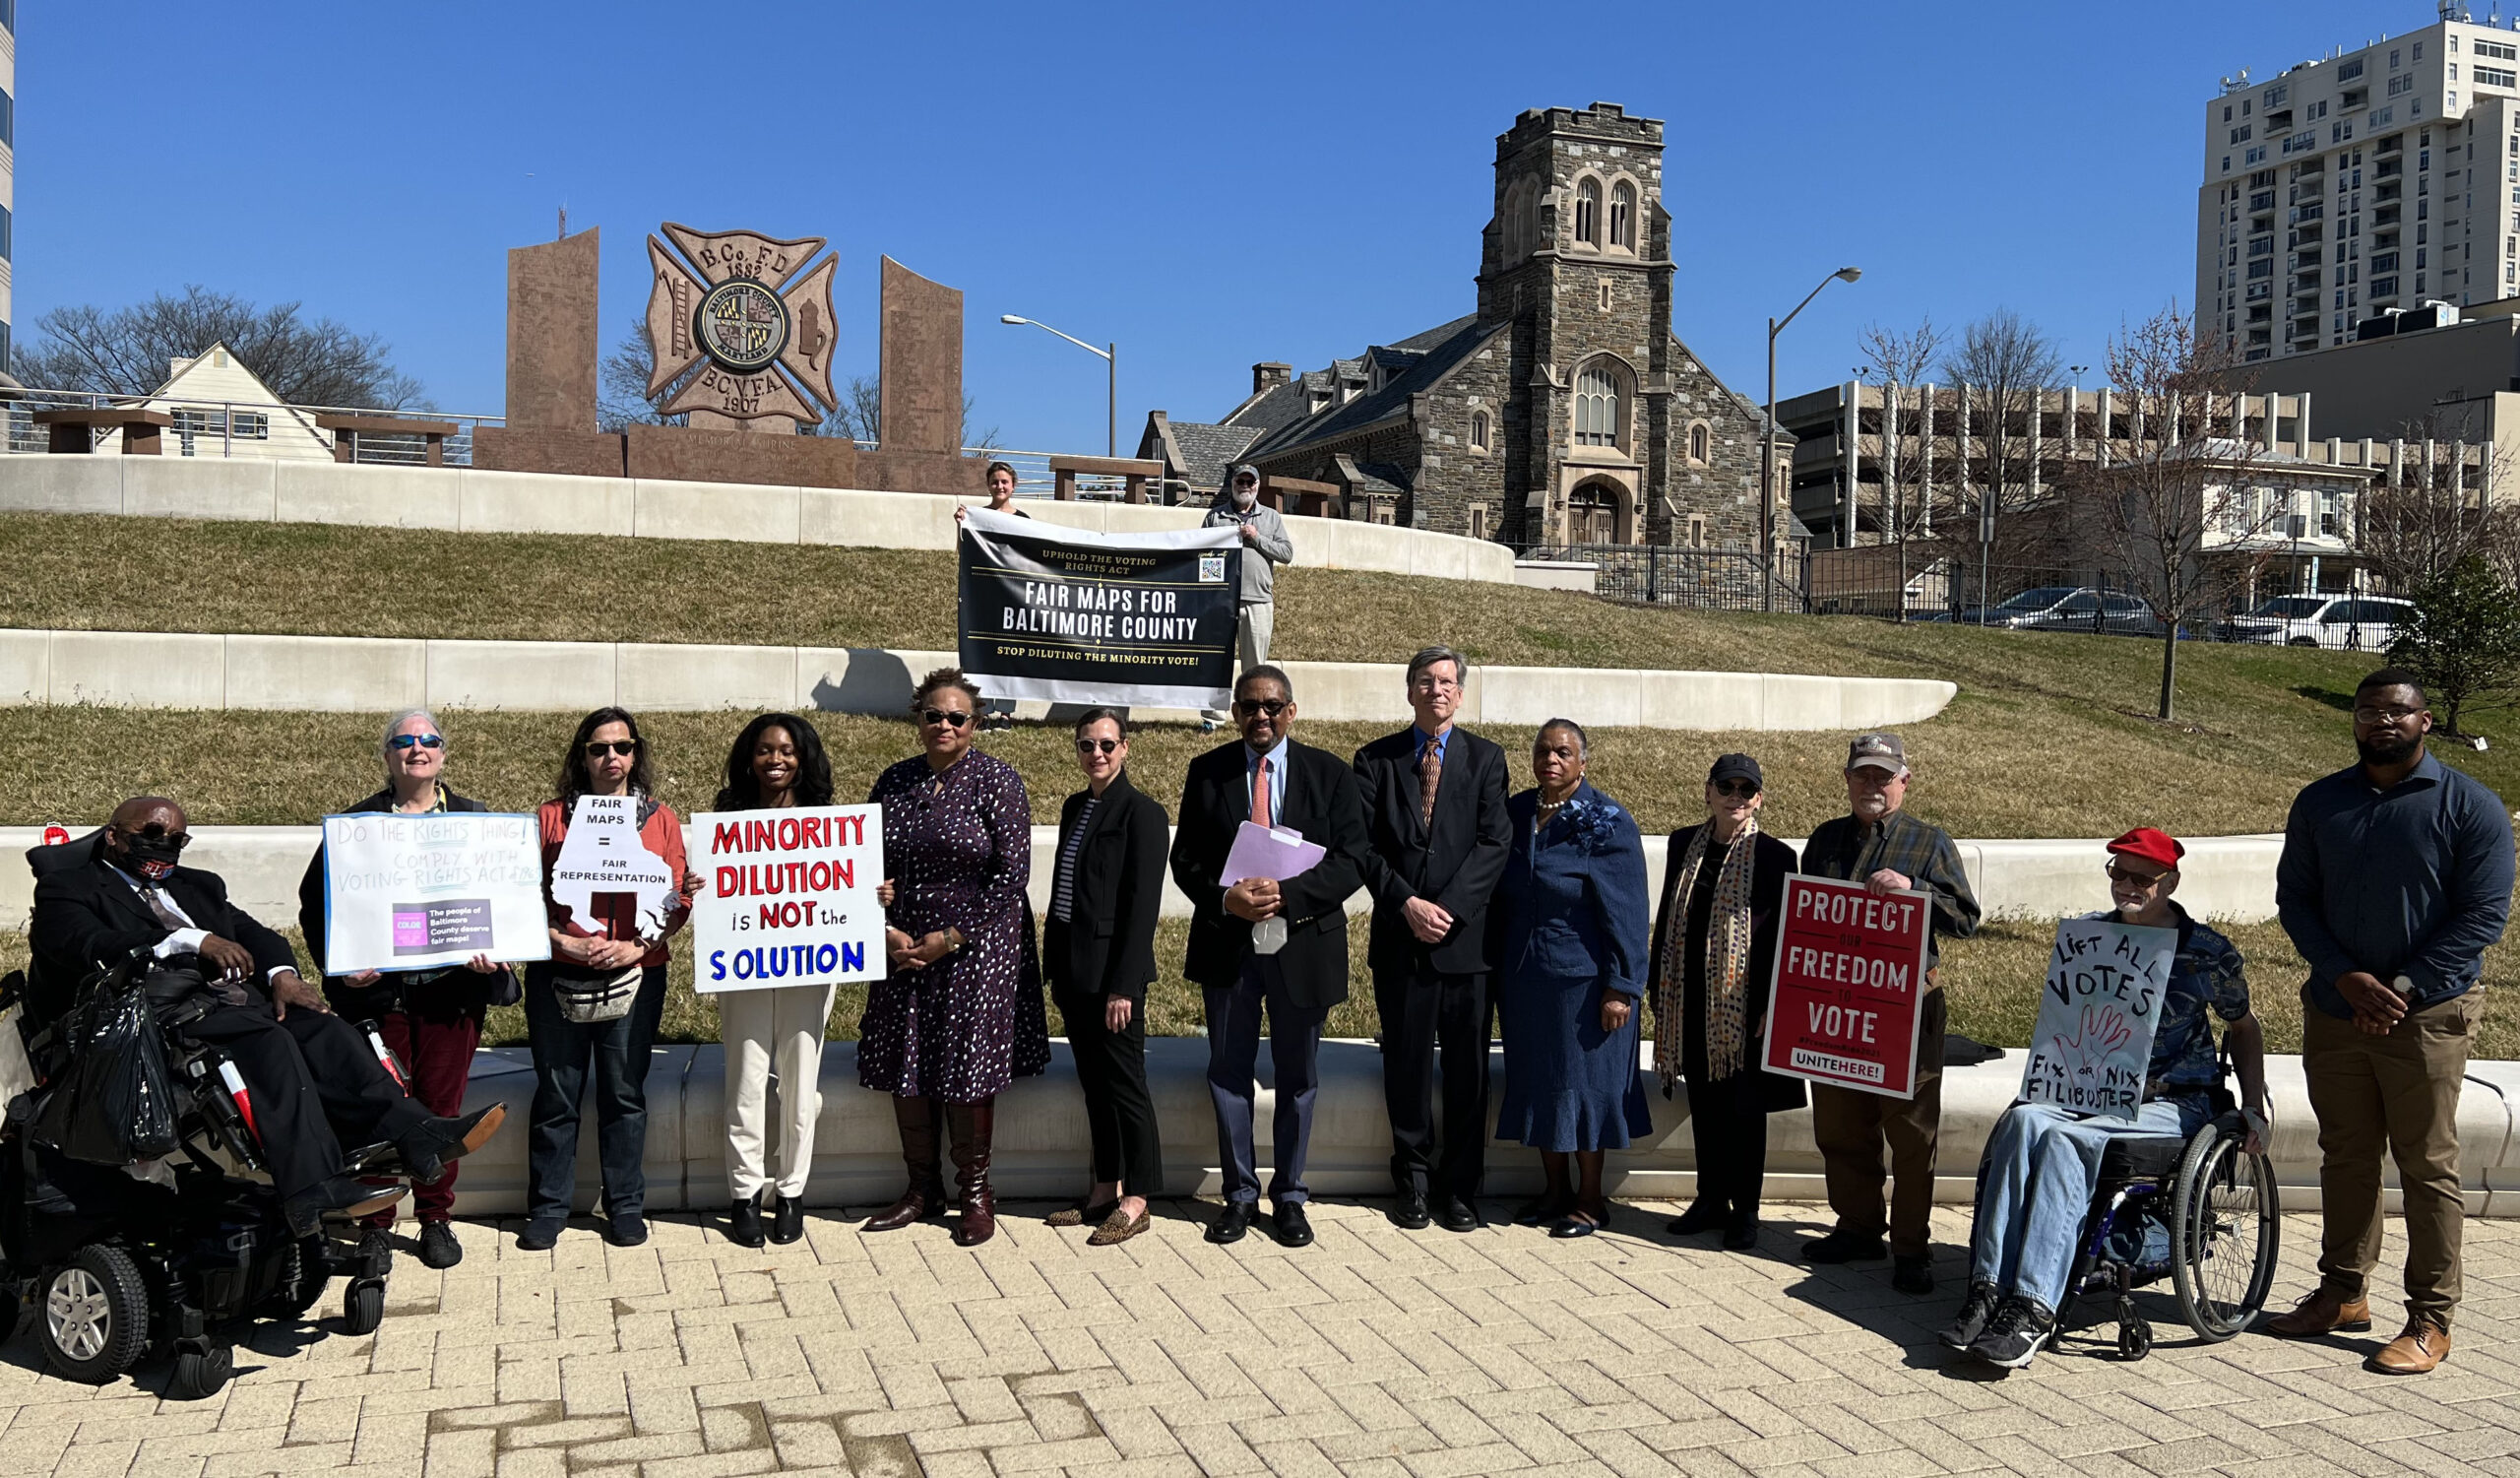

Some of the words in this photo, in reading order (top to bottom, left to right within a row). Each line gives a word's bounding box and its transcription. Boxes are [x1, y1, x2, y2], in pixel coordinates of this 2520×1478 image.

[727, 262, 761, 280] 1882
[709, 288, 750, 314] BALTIMORE
[752, 290, 779, 319] COUNTY
[717, 342, 768, 359] MARYLAND
[723, 397, 760, 413] 1907
[1042, 549, 1088, 561] UPHOLD
[1091, 554, 1112, 563] THE
[1115, 556, 1157, 567] VOTING
[1065, 562, 1105, 574] RIGHTS
[1108, 564, 1130, 575] ACT
[1025, 581, 1069, 608] FAIR
[1077, 586, 1133, 613] MAPS
[1140, 591, 1176, 613] FOR
[1003, 607, 1114, 638] BALTIMORE
[1122, 616, 1197, 641] COUNTY
[997, 646, 1025, 656] STOP
[1028, 648, 1081, 661] DILUTING
[1084, 652, 1106, 662] THE
[1109, 653, 1165, 666] MINORITY
[1167, 655, 1198, 666] VOTE!
[592, 799, 622, 808] FAIR
[378, 818, 405, 839] THE
[413, 820, 469, 840] RIGHTS
[587, 815, 625, 825] MAPS
[712, 814, 866, 855] MINORITY
[394, 851, 461, 869] COMPLY
[475, 850, 518, 866] WITH
[602, 860, 627, 868] FAIR
[338, 871, 409, 892] VOTING
[415, 868, 472, 888] RIGHTS
[477, 867, 507, 883] ACT
[560, 871, 666, 884] REPRESENTATION
[716, 859, 854, 898] DILUTION
[430, 917, 468, 926] Baltimore
[445, 907, 472, 917] people
[473, 906, 481, 915] of
[732, 913, 750, 931] is
[760, 901, 817, 930] NOT
[821, 909, 847, 925] the
[1796, 889, 1915, 934] PROTECT
[431, 926, 459, 935] County
[446, 935, 470, 944] maps!
[1839, 933, 1861, 948] OUR
[710, 941, 864, 980] SOLUTION
[1788, 946, 1908, 993] FREEDOM
[2114, 934, 2157, 984] ALL
[1837, 989, 1852, 1002] TO
[2048, 965, 2154, 1017] VOTES
[1808, 1001, 1878, 1044] VOTE
[1796, 1052, 1879, 1079] UNITEHERE!
[2032, 1054, 2065, 1079] FIX
[2106, 1067, 2141, 1088] NIX
[2026, 1078, 2136, 1117] FILIBUSTER
